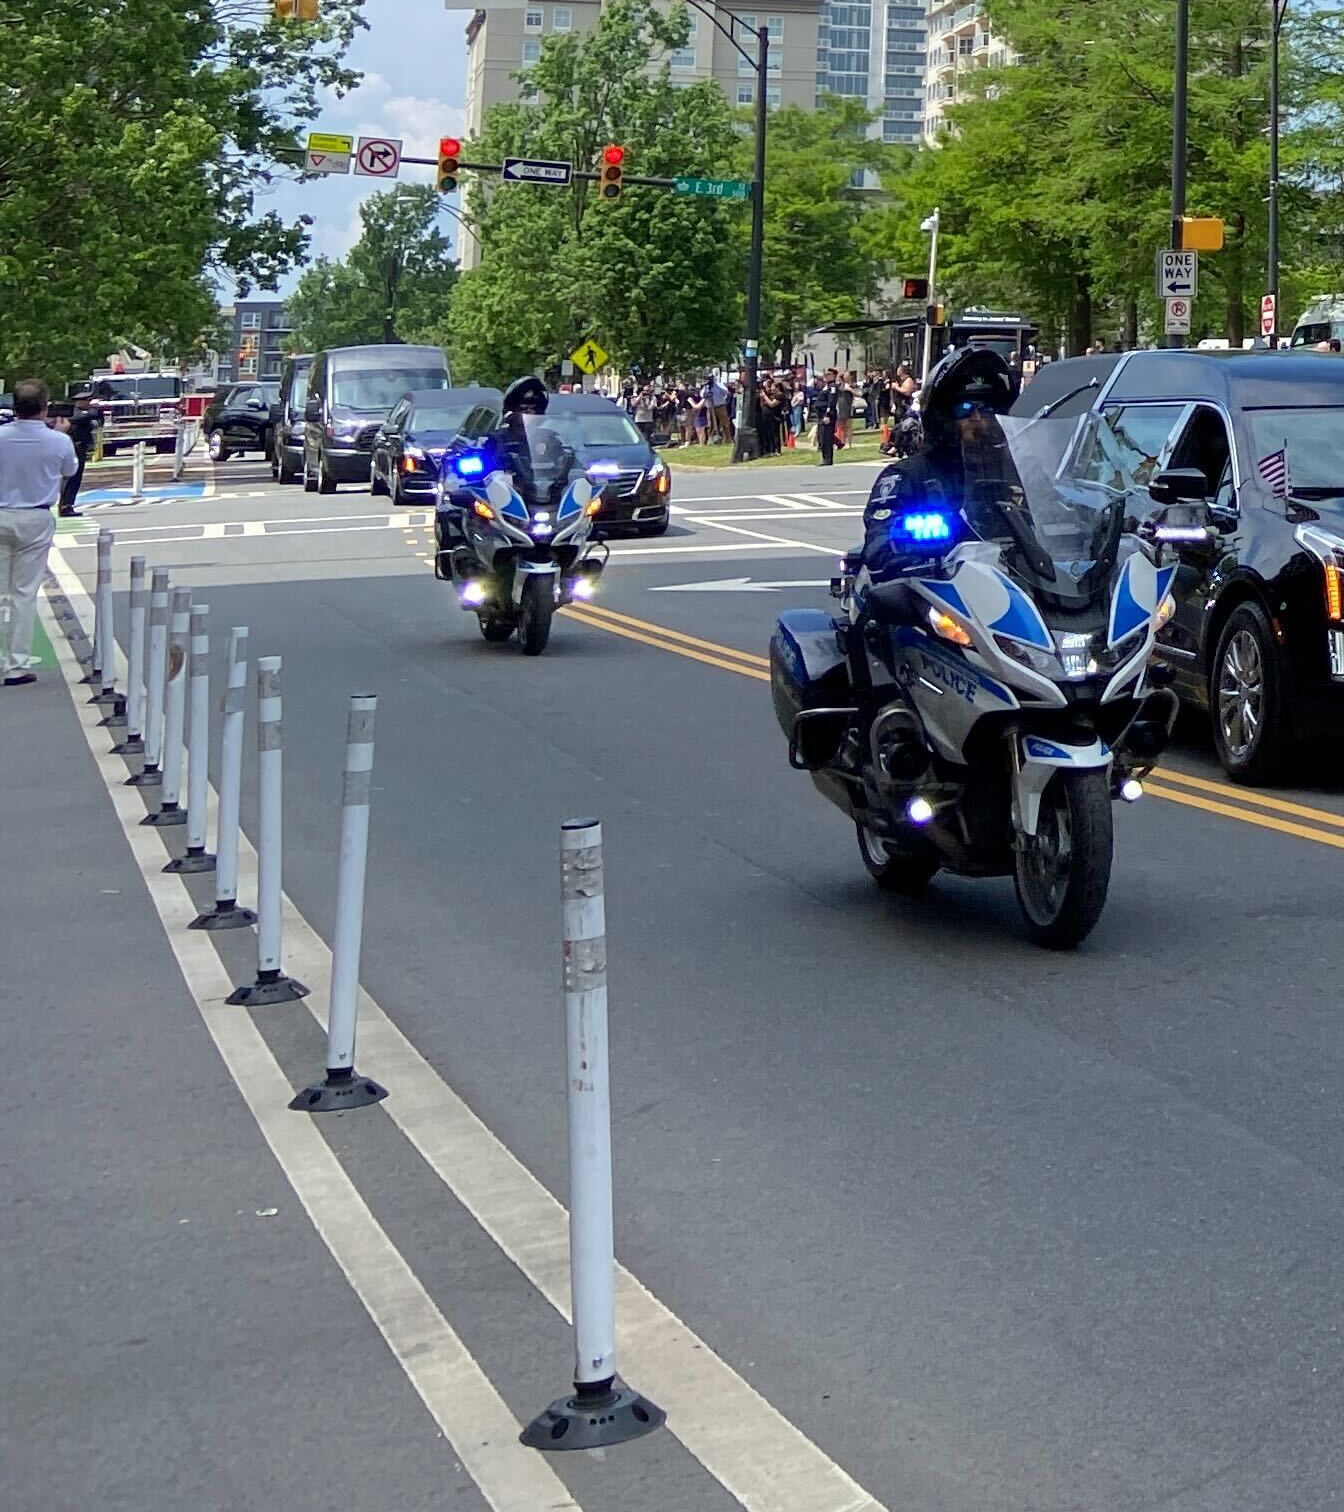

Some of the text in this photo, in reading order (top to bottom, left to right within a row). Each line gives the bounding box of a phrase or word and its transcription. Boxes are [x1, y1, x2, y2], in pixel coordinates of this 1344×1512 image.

[523, 166, 563, 177] ONE WAY
[705, 182, 724, 195] 3rd
[1165, 254, 1193, 266] ONE
[1164, 267, 1193, 279] WAY
